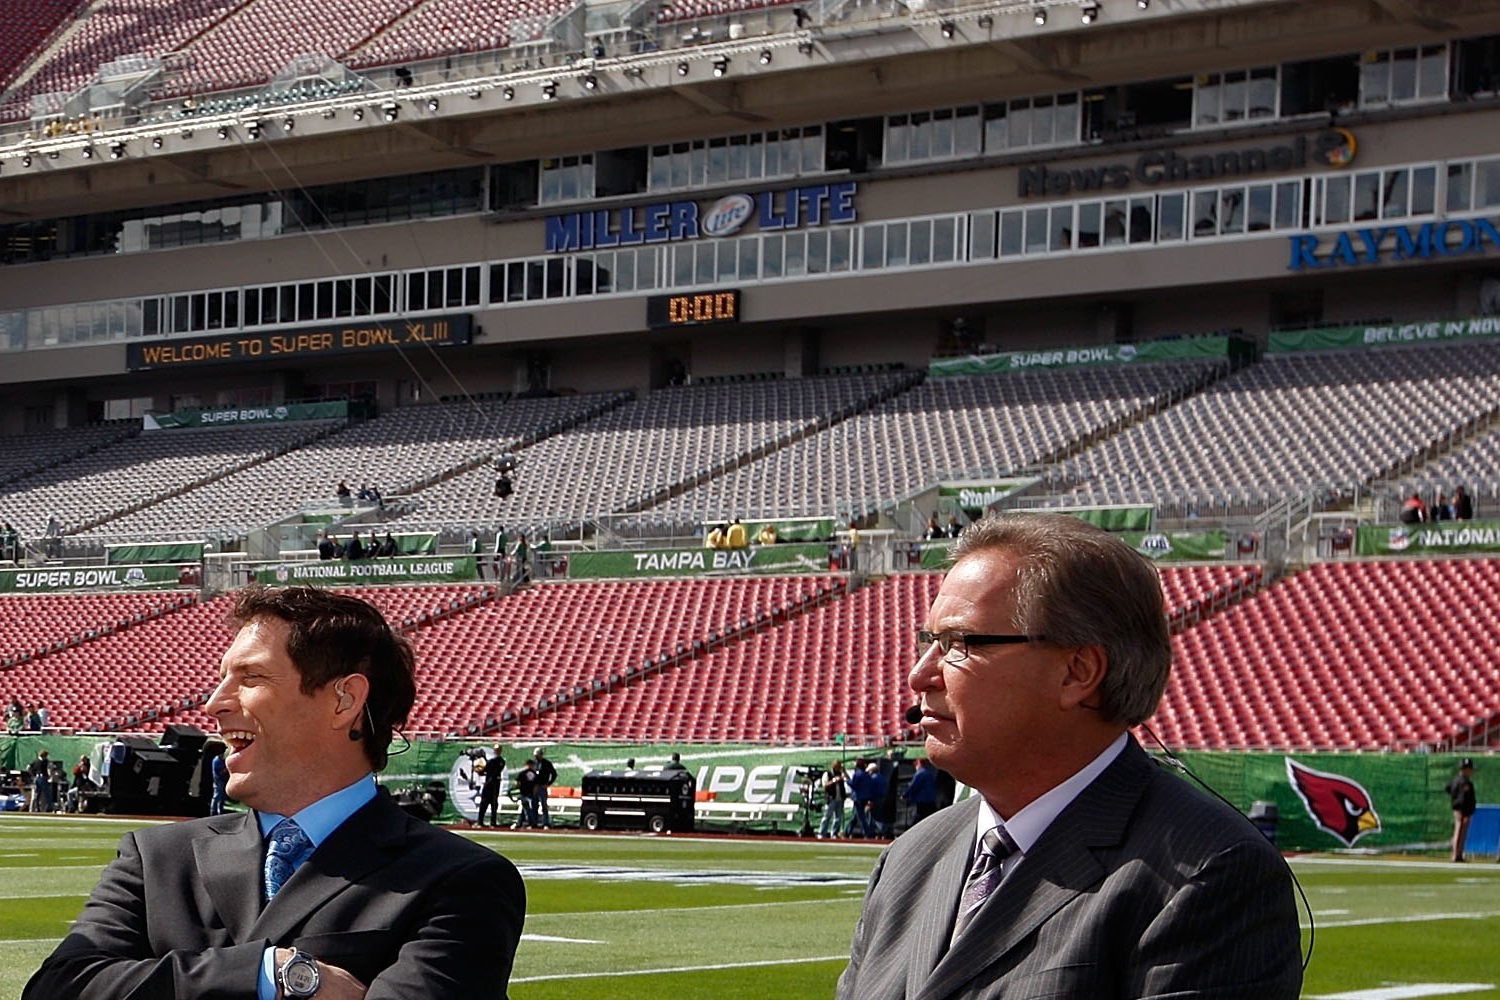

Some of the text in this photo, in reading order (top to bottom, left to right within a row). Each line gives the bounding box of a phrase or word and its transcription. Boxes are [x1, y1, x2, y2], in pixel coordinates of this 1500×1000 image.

[1018, 165, 1131, 198] News
[1135, 136, 1306, 186] Channel
[545, 181, 858, 253] MILLER LITE
[669, 292, 735, 323] 0:00
[143, 320, 449, 364] WELCOME TO SUPER BOWL XLIII
[1009, 351, 1064, 368] SUPER
[1066, 347, 1114, 363] BOWL
[201, 411, 238, 423] SUPER
[239, 408, 272, 420] BOWL
[293, 566, 346, 578] NATIONAL
[350, 564, 407, 577] FOOTBALL
[410, 562, 454, 575] LEAGUE
[634, 550, 757, 570] TAMPA BAY
[16, 572, 70, 587] SUPER
[73, 571, 122, 585] BOWL
